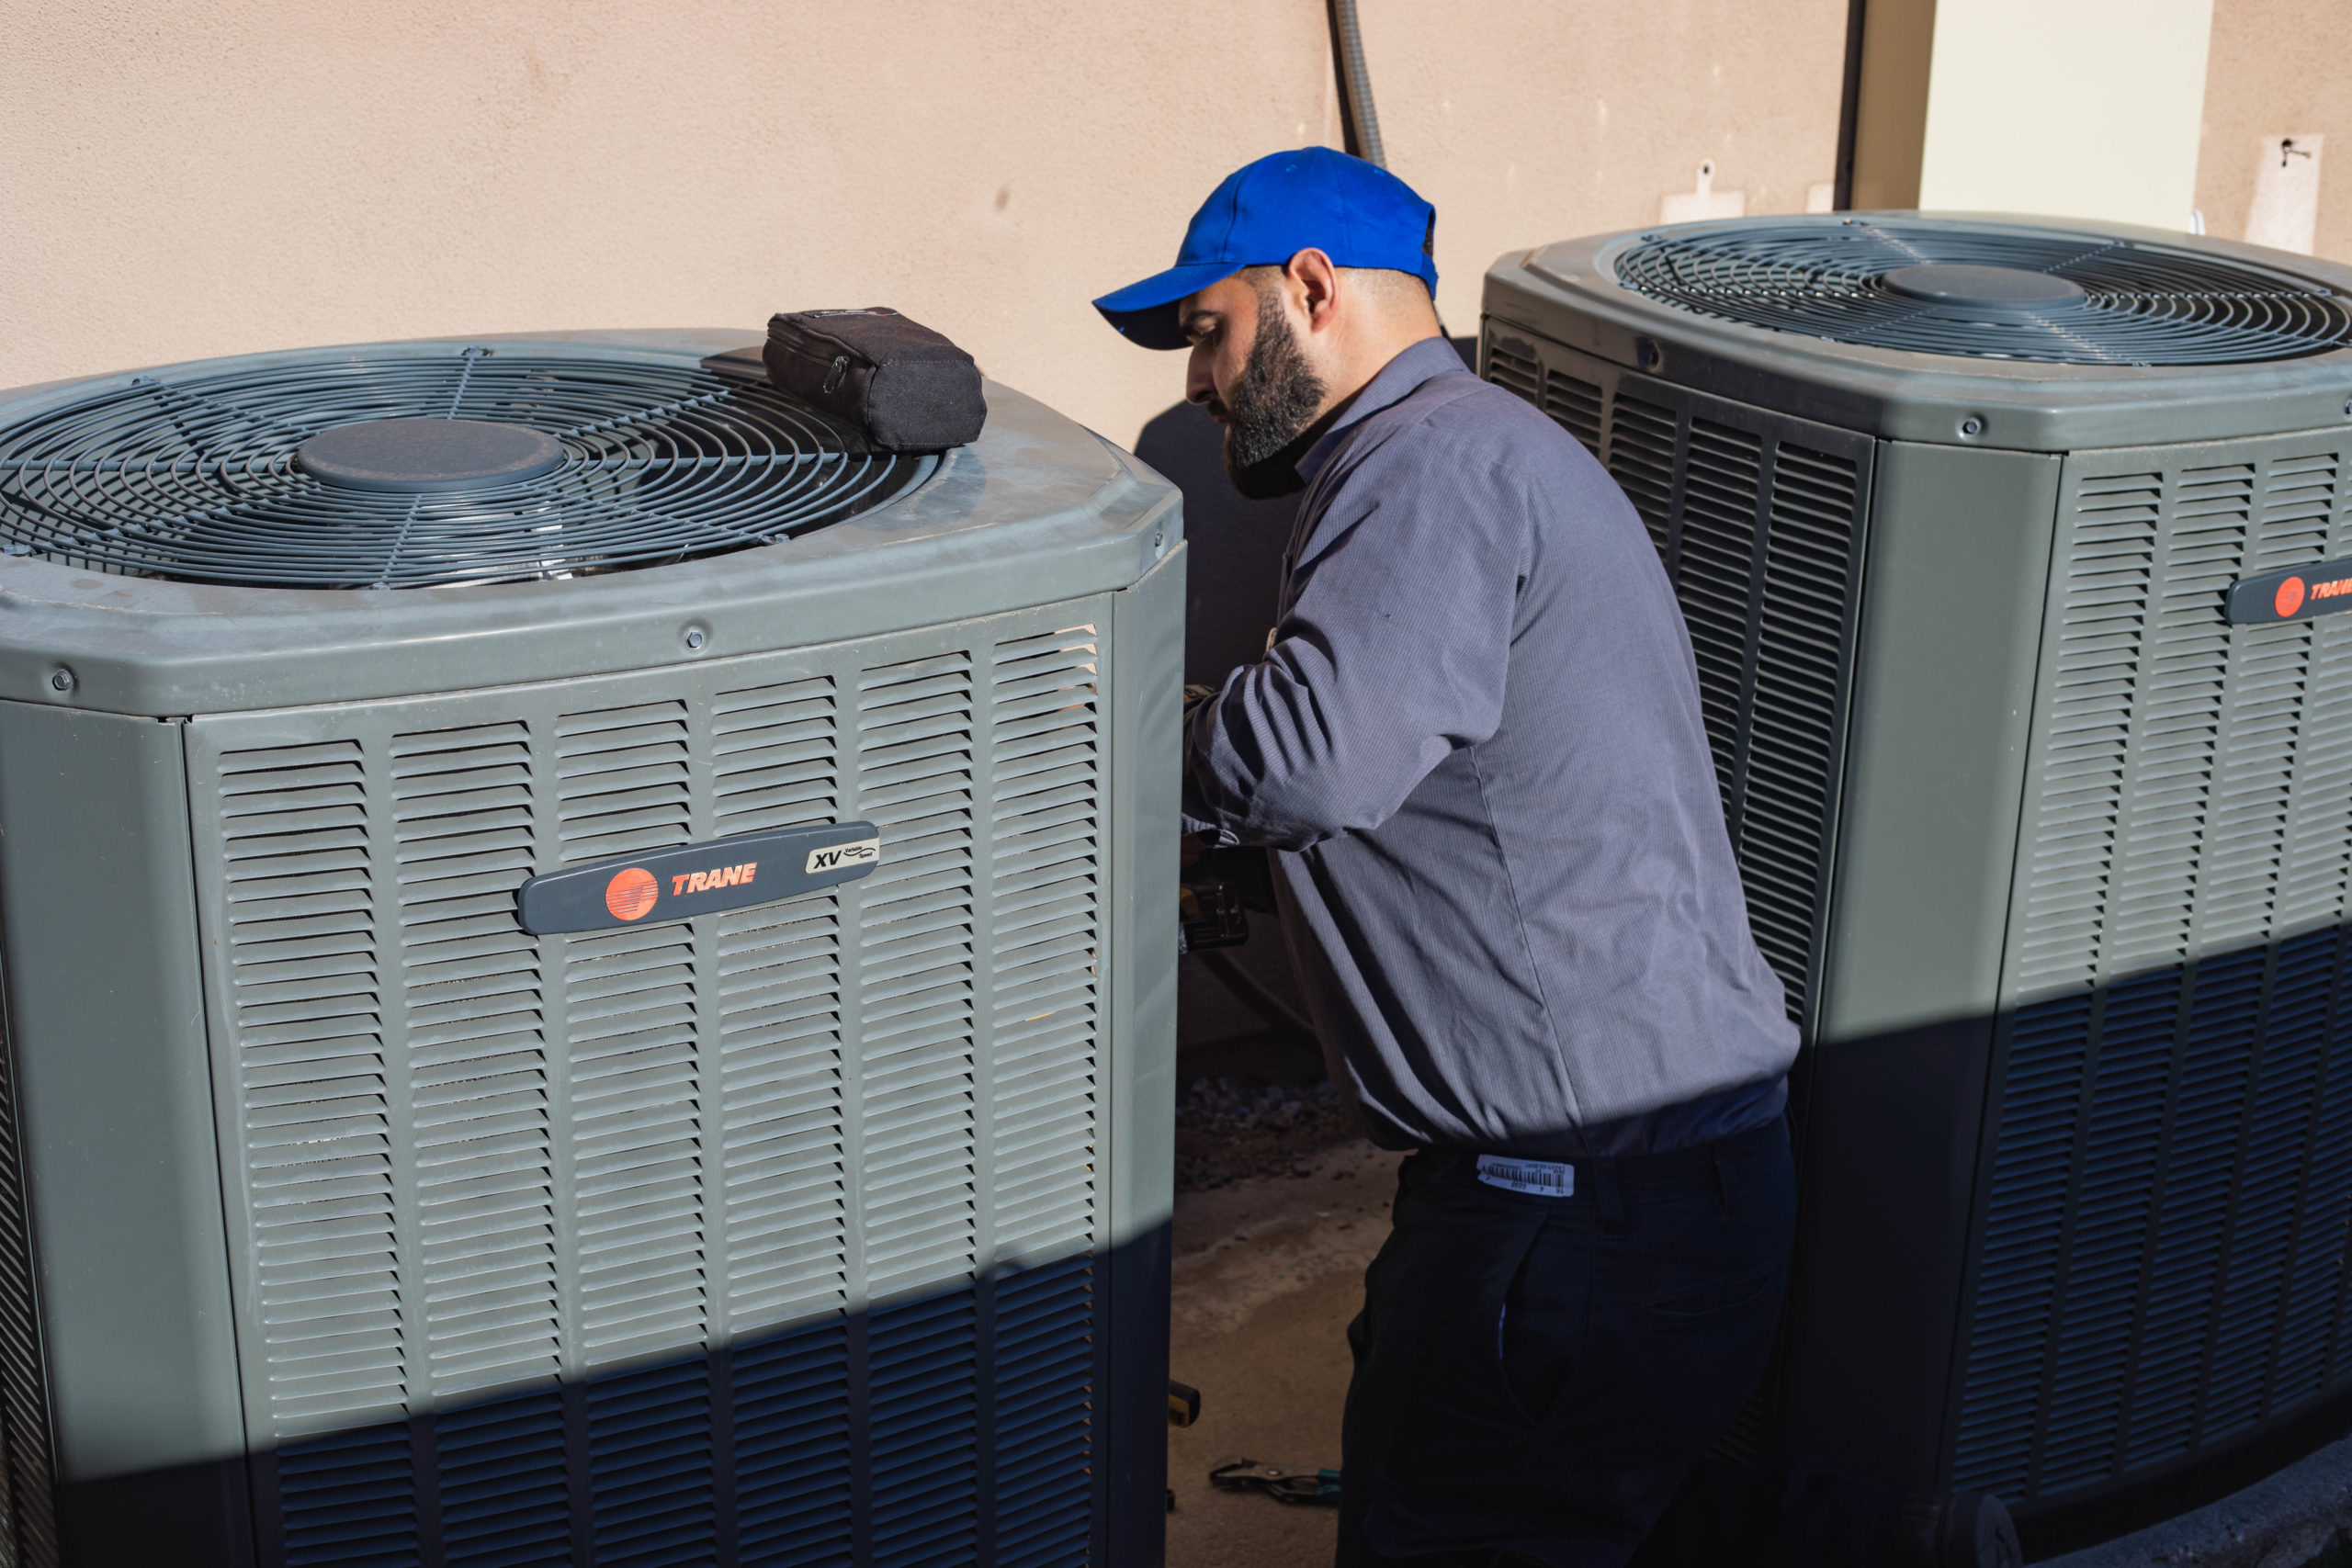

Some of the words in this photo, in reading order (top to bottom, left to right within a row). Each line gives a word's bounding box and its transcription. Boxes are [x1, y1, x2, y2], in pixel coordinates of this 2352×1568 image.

[844, 845, 863, 853] Variable
[813, 850, 842, 869] XV
[671, 862, 758, 897] TRANE
